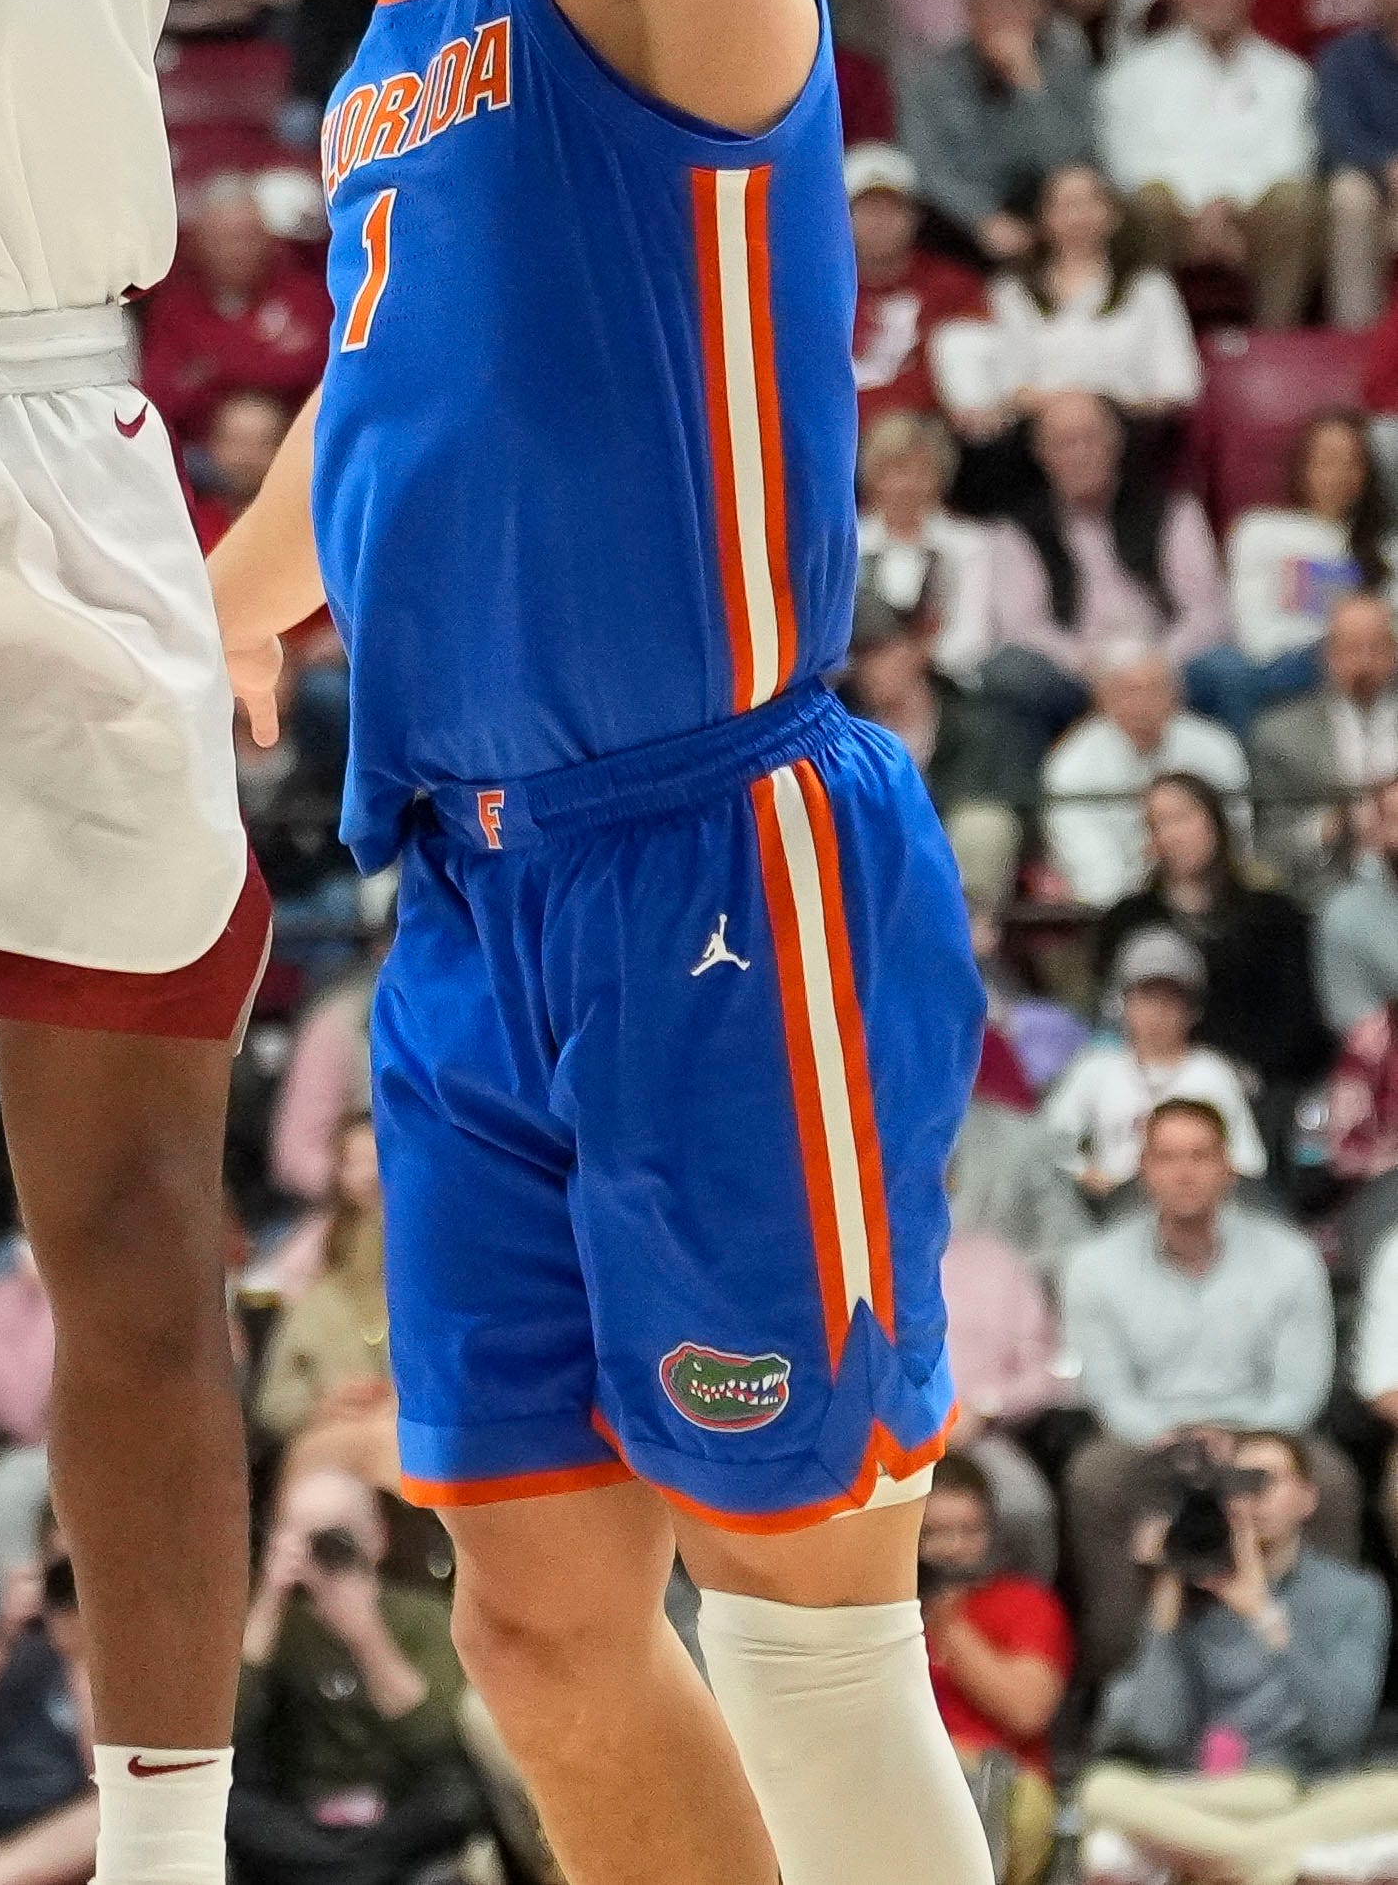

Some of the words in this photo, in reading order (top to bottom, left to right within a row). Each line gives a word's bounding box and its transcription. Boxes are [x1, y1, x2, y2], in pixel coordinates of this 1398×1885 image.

[321, 16, 511, 205] LORIDA
[340, 187, 398, 353] 1
[477, 790, 505, 849] F
